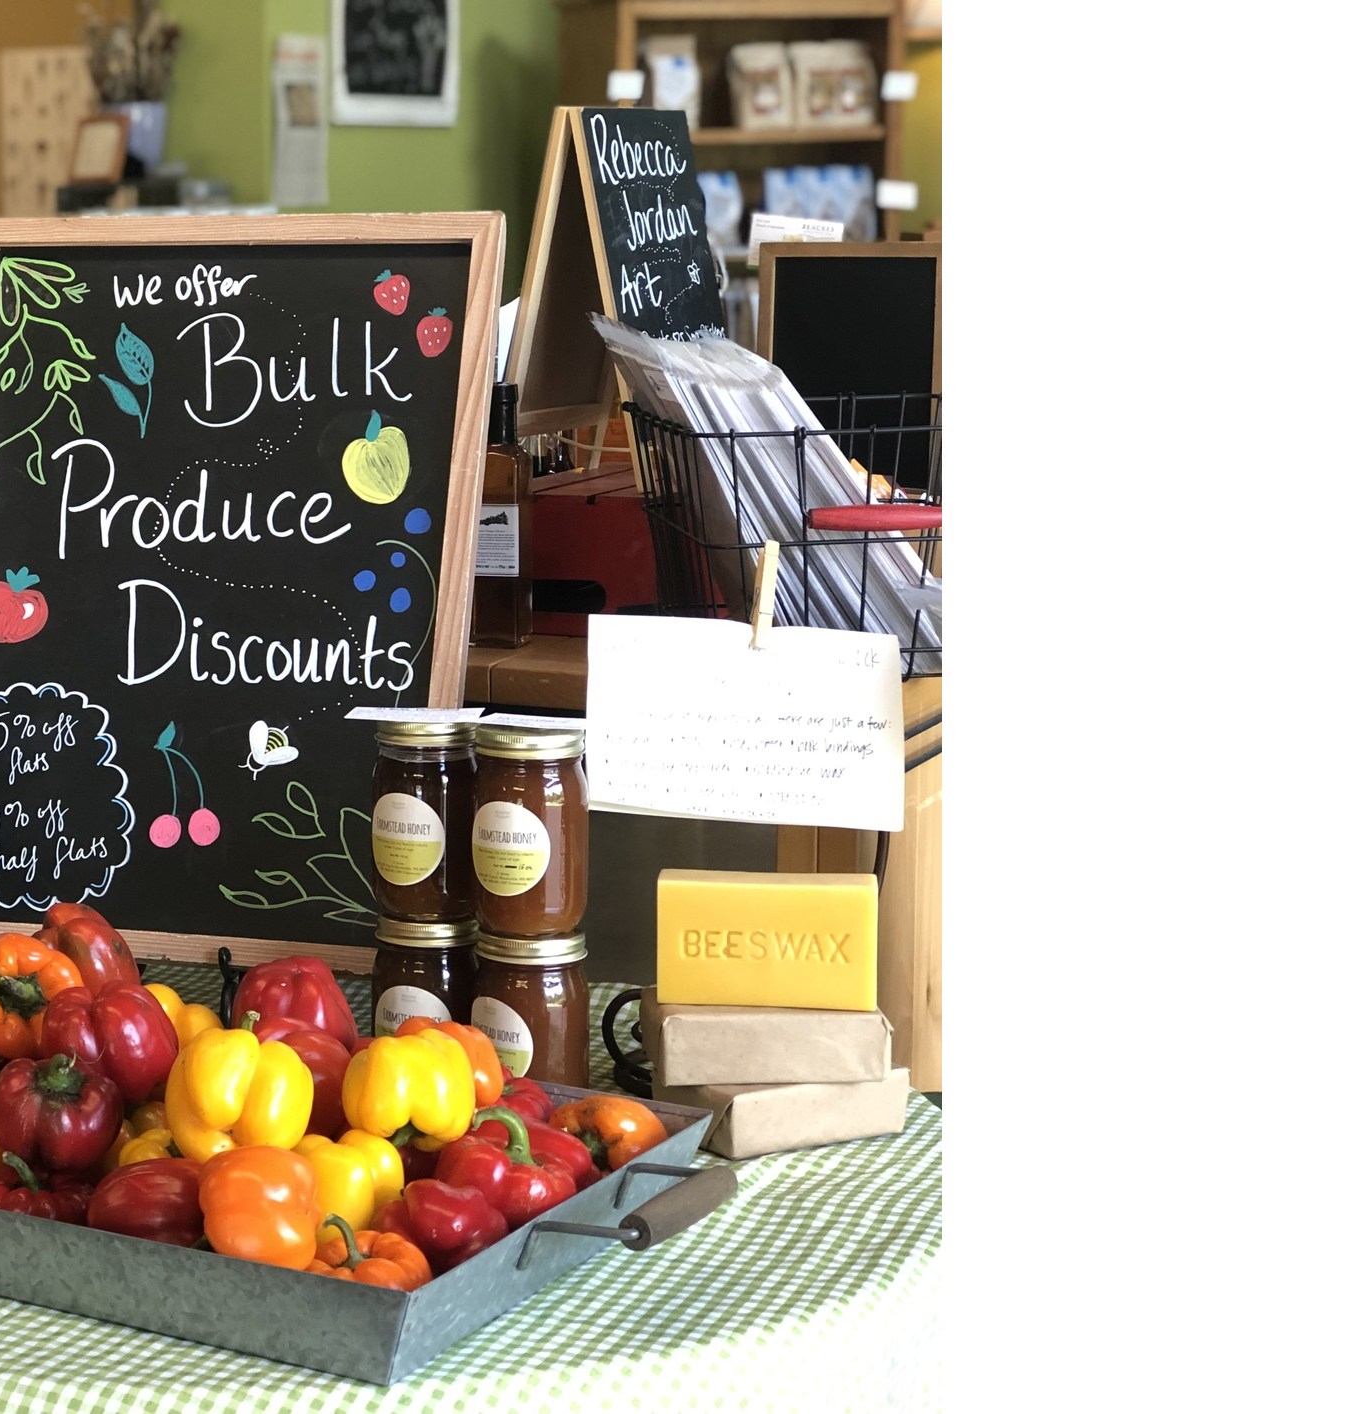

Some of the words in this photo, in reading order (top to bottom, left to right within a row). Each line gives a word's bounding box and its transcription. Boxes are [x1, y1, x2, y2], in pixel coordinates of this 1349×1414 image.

[590, 113, 687, 185] Rebecca
[622, 189, 698, 251] Jordan
[175, 263, 258, 307] offer
[620, 261, 663, 317] Art
[177, 312, 413, 427] Bulk
[51, 438, 352, 559] Produce
[117, 578, 414, 691] Discounts
[43, 712, 79, 752] off
[807, 716, 824, 724] are
[829, 716, 853, 733] just
[857, 720, 864, 728] a
[8, 746, 50, 785] flats
[38, 799, 69, 839] off
[407, 823, 431, 836] HONEY
[512, 832, 538, 845] HONEY
[53, 836, 108, 879] flats
[682, 929, 851, 964] BEESWAX
[497, 1029, 520, 1044] HONEY
